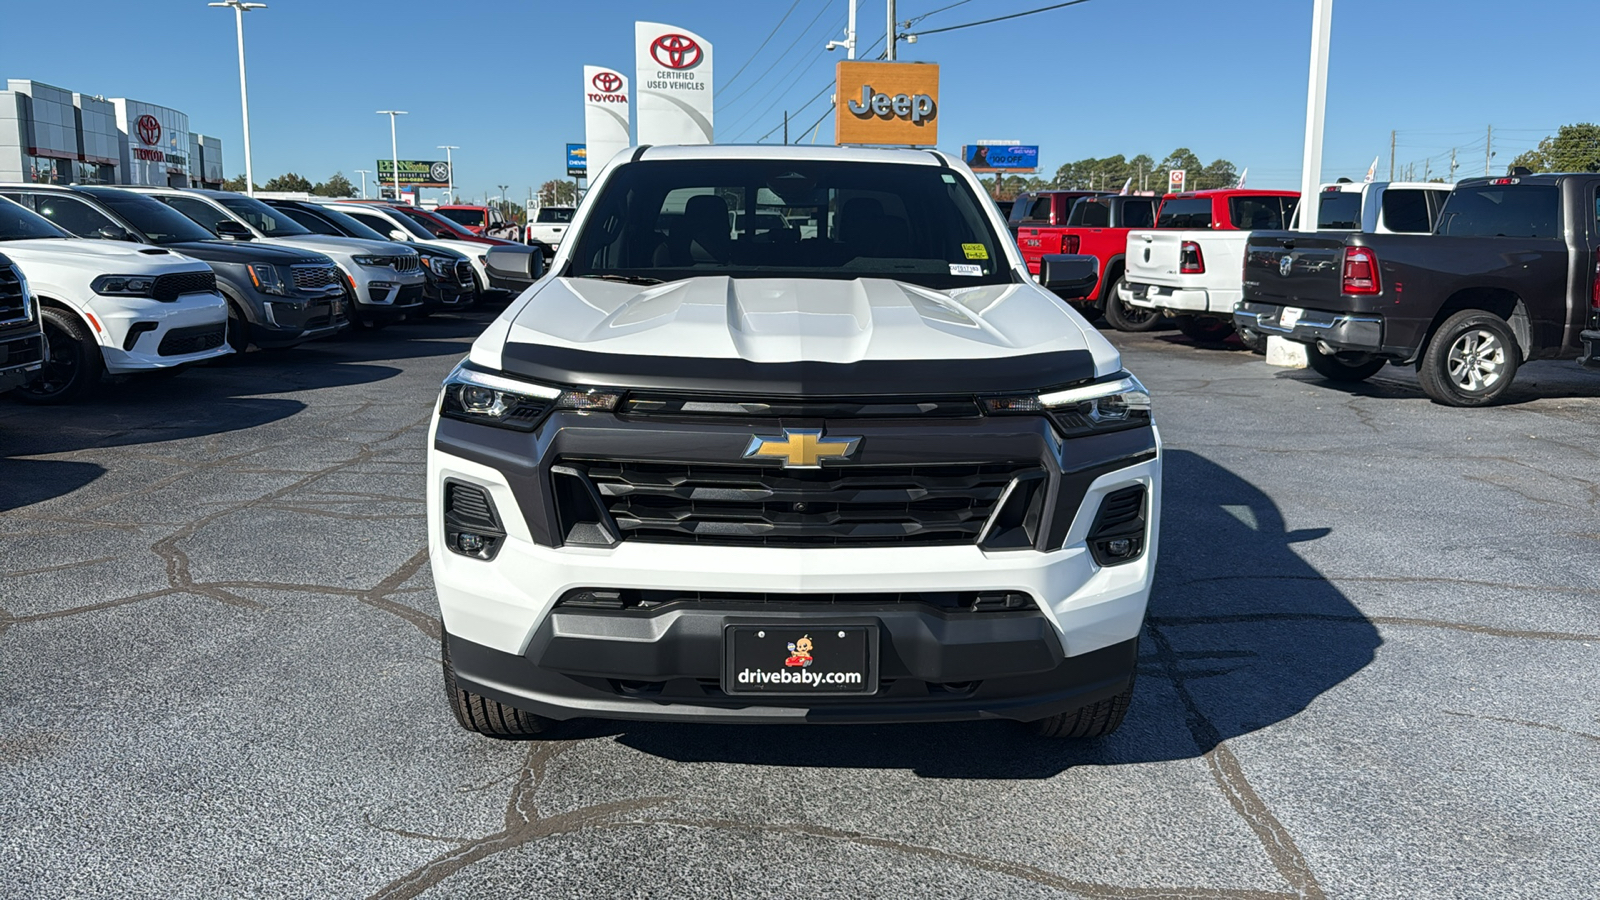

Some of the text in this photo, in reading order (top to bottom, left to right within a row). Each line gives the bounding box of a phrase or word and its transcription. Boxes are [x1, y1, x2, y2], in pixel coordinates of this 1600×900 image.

[656, 71, 695, 80] CERTIFIED
[647, 81, 705, 91] USED VEHICLES
[587, 93, 628, 104] TOYOTA
[848, 85, 933, 122] Jeep
[132, 148, 165, 162] TOYOTA
[738, 668, 861, 687] drivebaby.com
